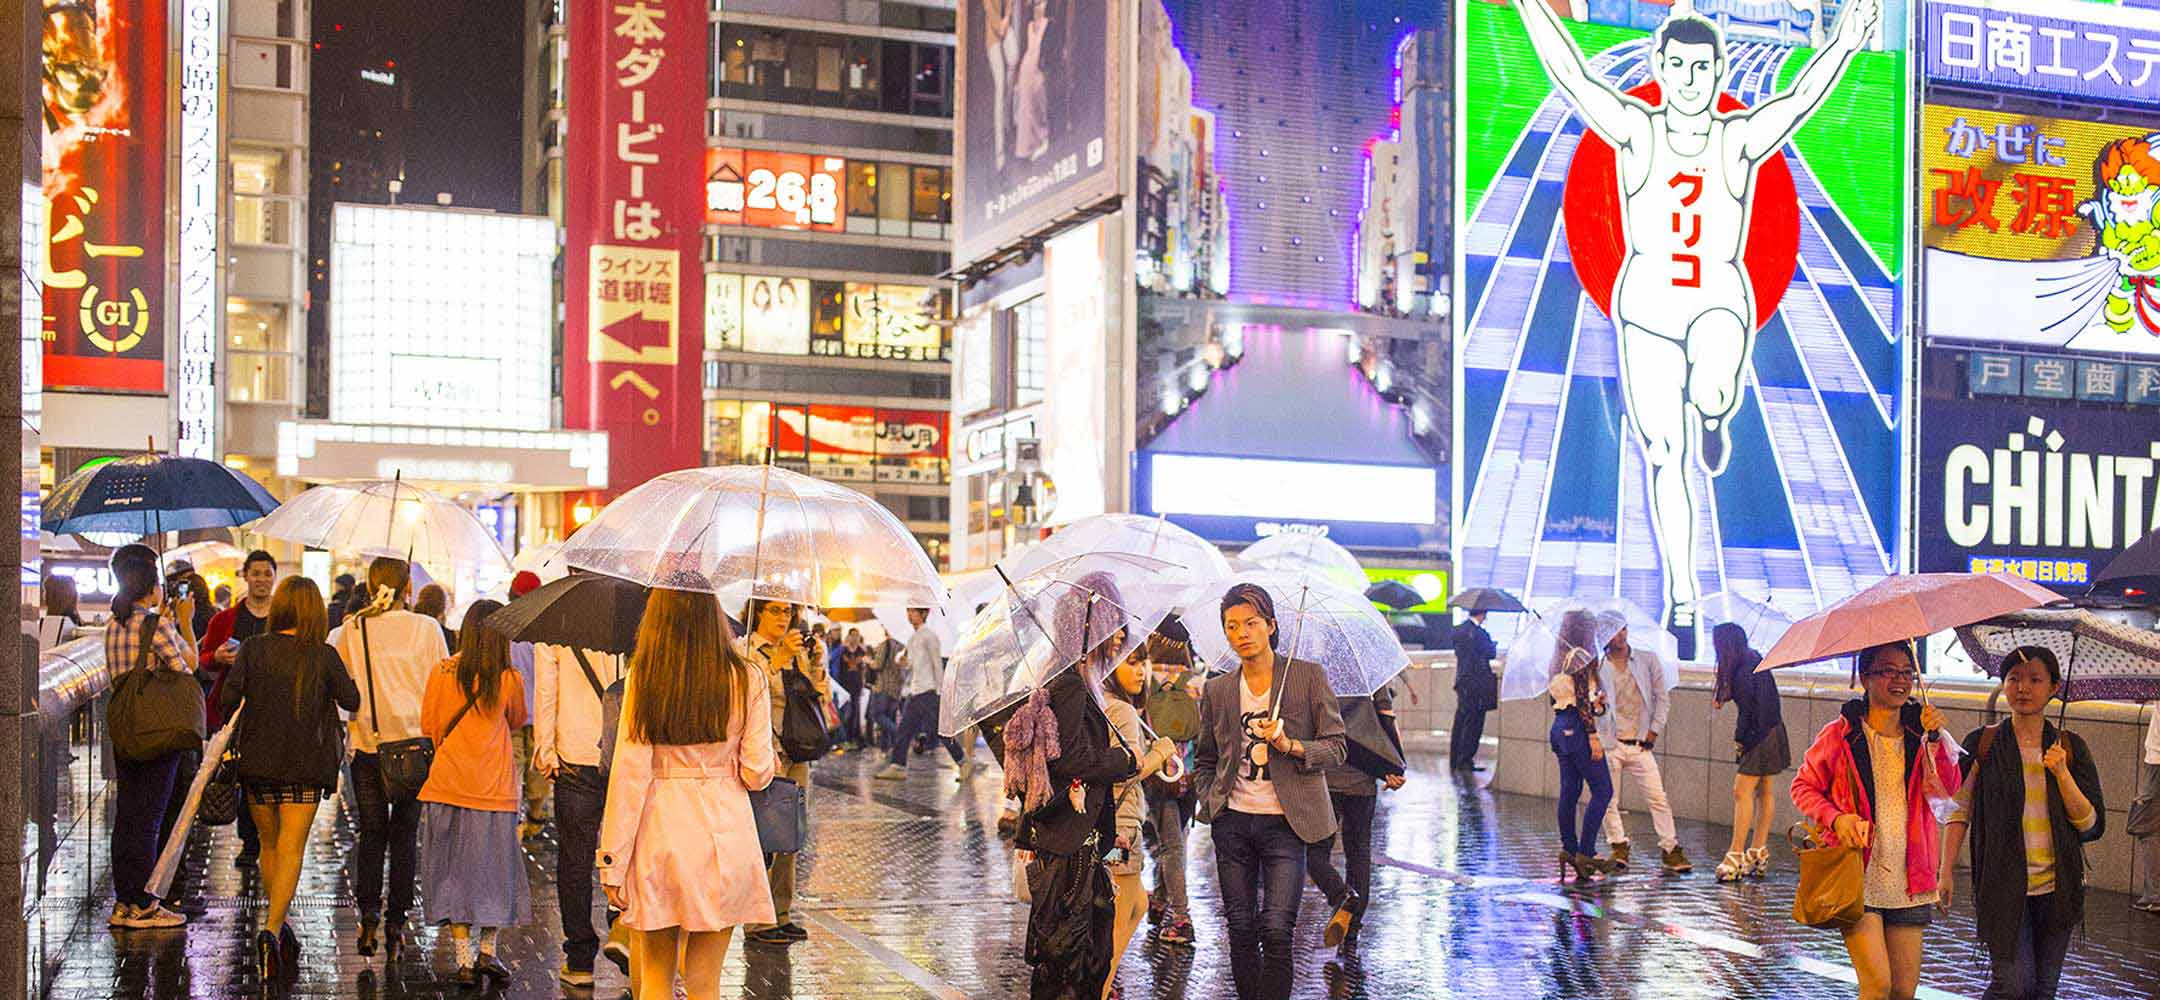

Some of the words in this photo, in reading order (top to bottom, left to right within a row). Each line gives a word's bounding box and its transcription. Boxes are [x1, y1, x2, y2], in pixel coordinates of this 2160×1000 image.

[613, 0, 666, 241] 本ダービーは
[1946, 116, 2067, 167] かぜに
[1668, 167, 1707, 288] グリコ
[1930, 166, 2079, 239] 改源
[598, 256, 672, 277] ウインズ
[598, 278, 673, 304] 道頓堀
[96, 301, 131, 326] GI
